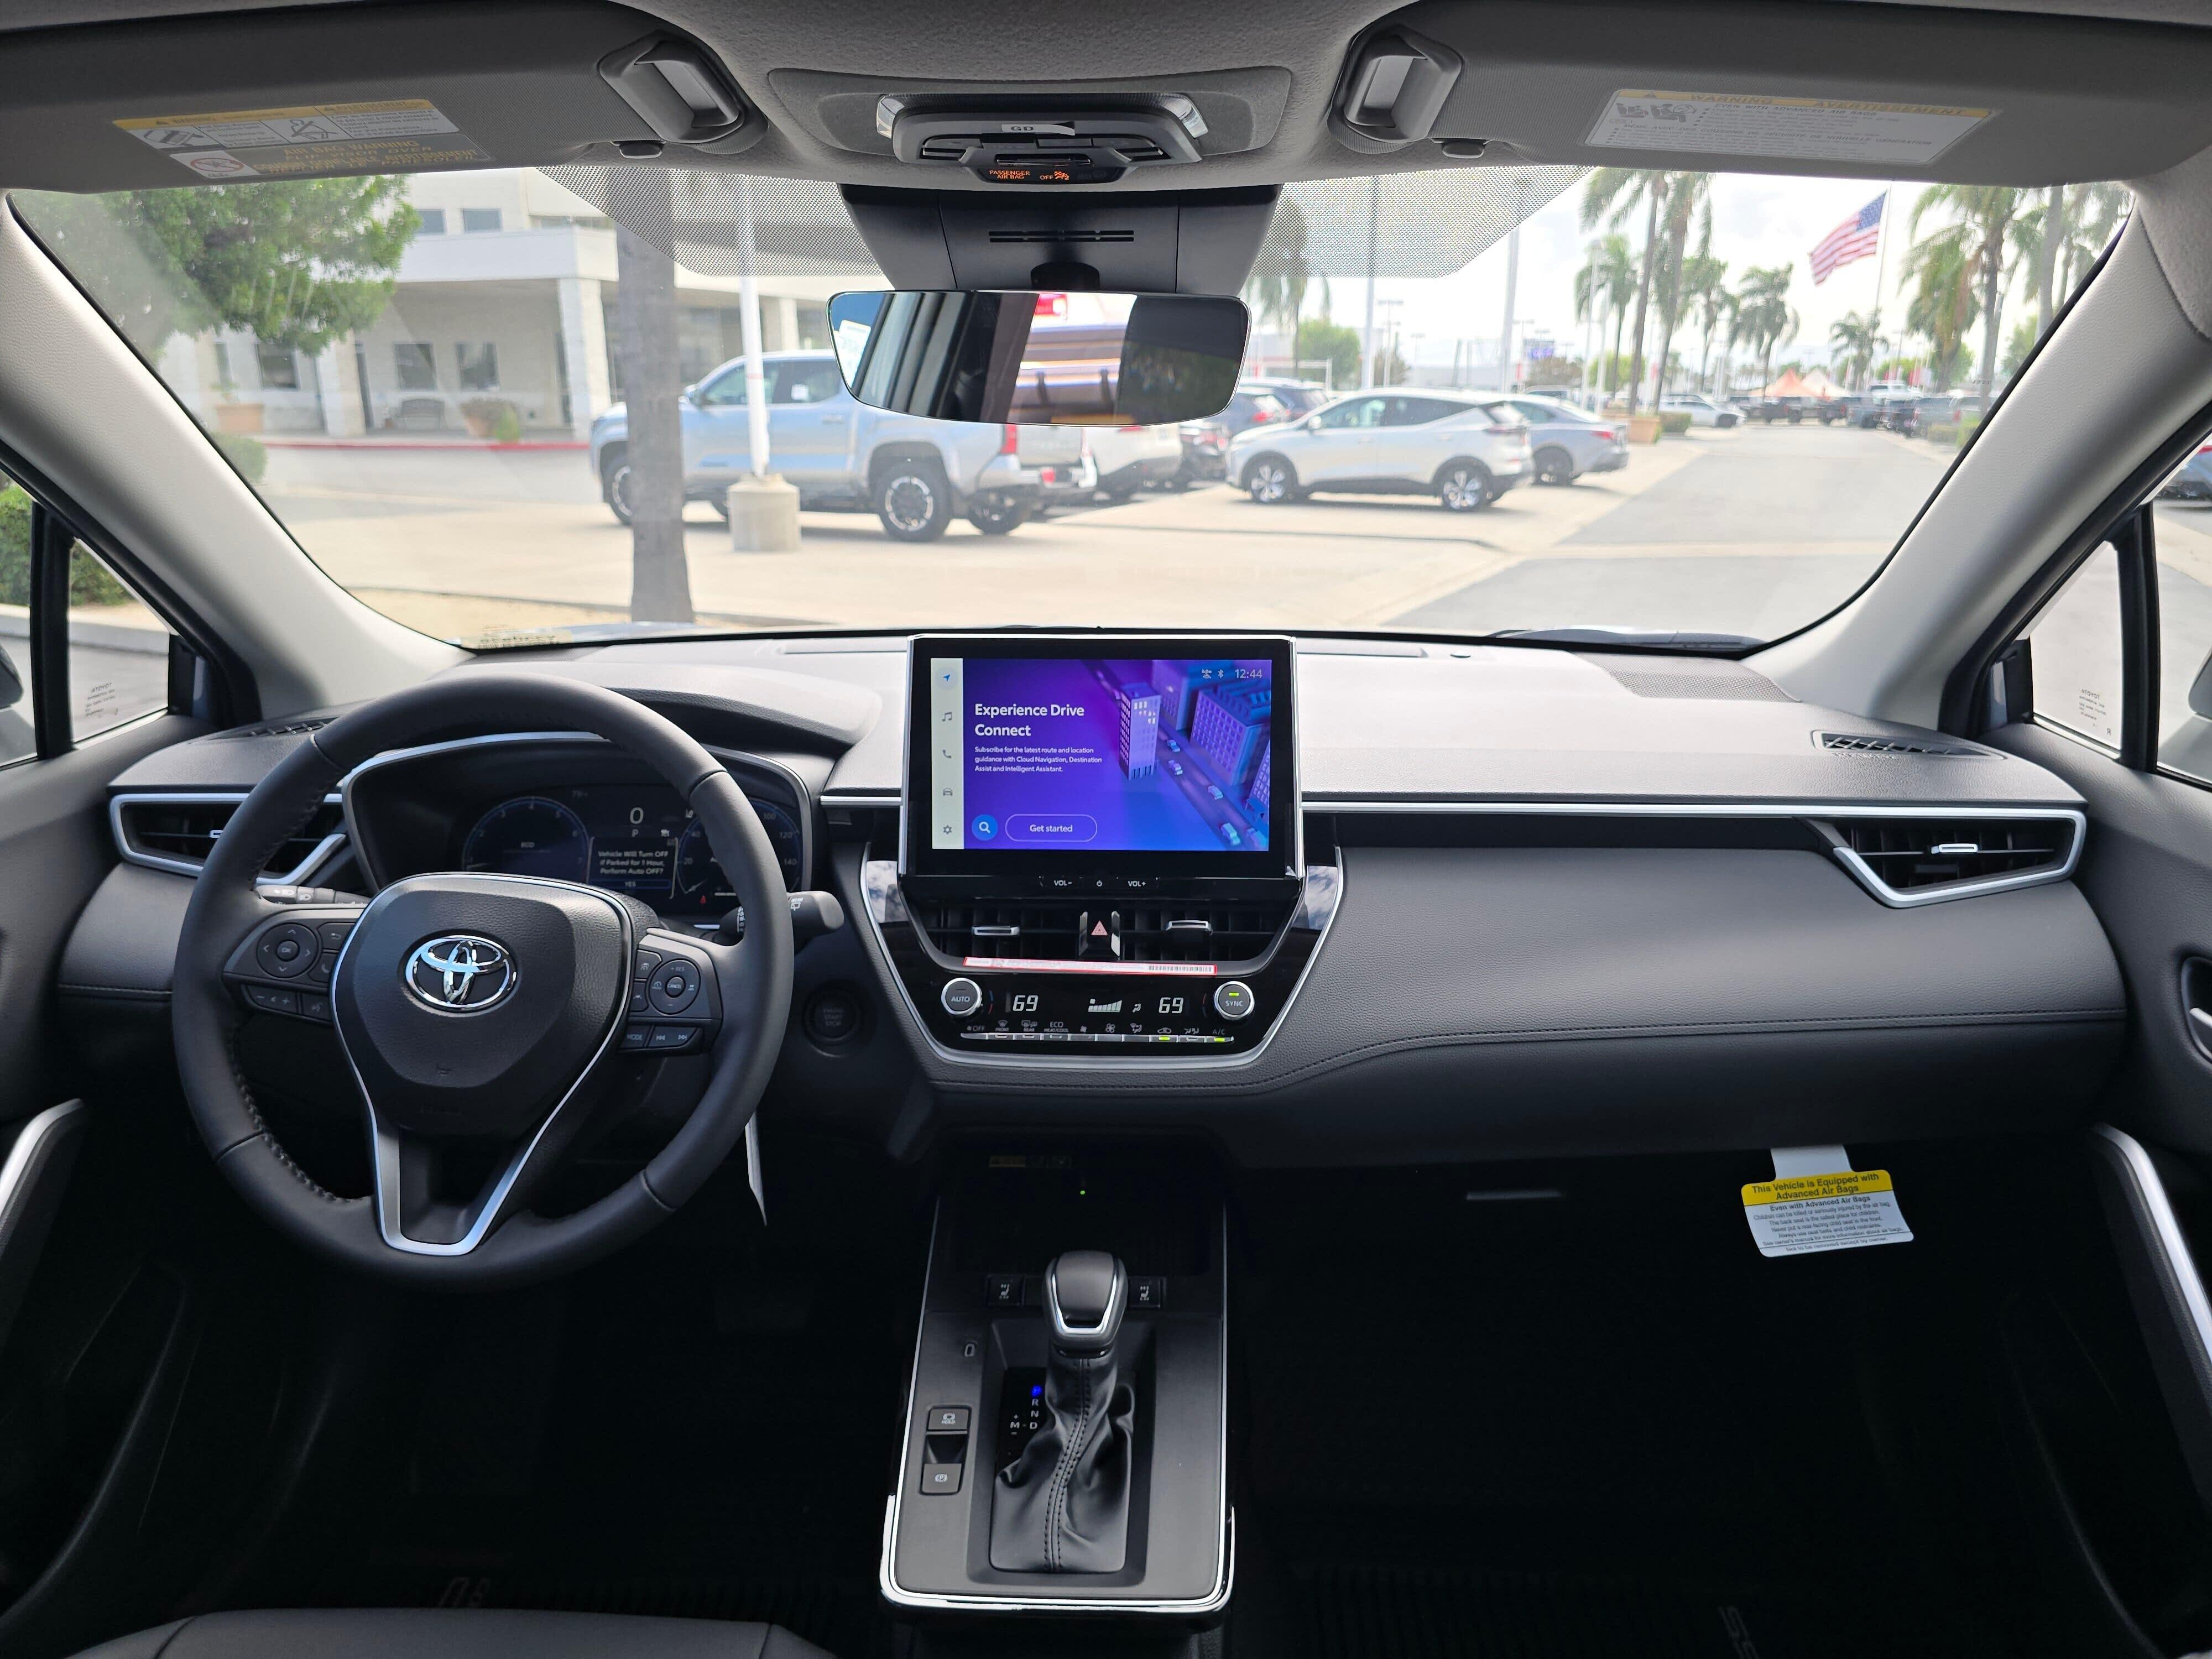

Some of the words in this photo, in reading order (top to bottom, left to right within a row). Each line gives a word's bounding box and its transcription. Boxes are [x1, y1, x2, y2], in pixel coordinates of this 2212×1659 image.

[1235, 669, 1262, 679] 12:44
[975, 703, 1048, 718] Experience
[1051, 704, 1084, 716] Drive
[974, 724, 1031, 737] Connect
[630, 807, 644, 824] 0
[632, 829, 639, 837] P
[1029, 824, 1044, 833] Get
[1046, 823, 1073, 833] started
[1012, 995, 1039, 1012] 69
[1159, 997, 1184, 1014] 69
[1752, 1185, 1771, 1193] This
[1773, 1181, 1805, 1191] Vehicle
[1817, 1174, 1859, 1187] Equipped
[1861, 1173, 1880, 1182] with
[1776, 1187, 1819, 1200] Advanced
[1822, 1186, 1833, 1195] Air
[1837, 1184, 1859, 1194] Bags
[1806, 1198, 1839, 1208] Advanced
